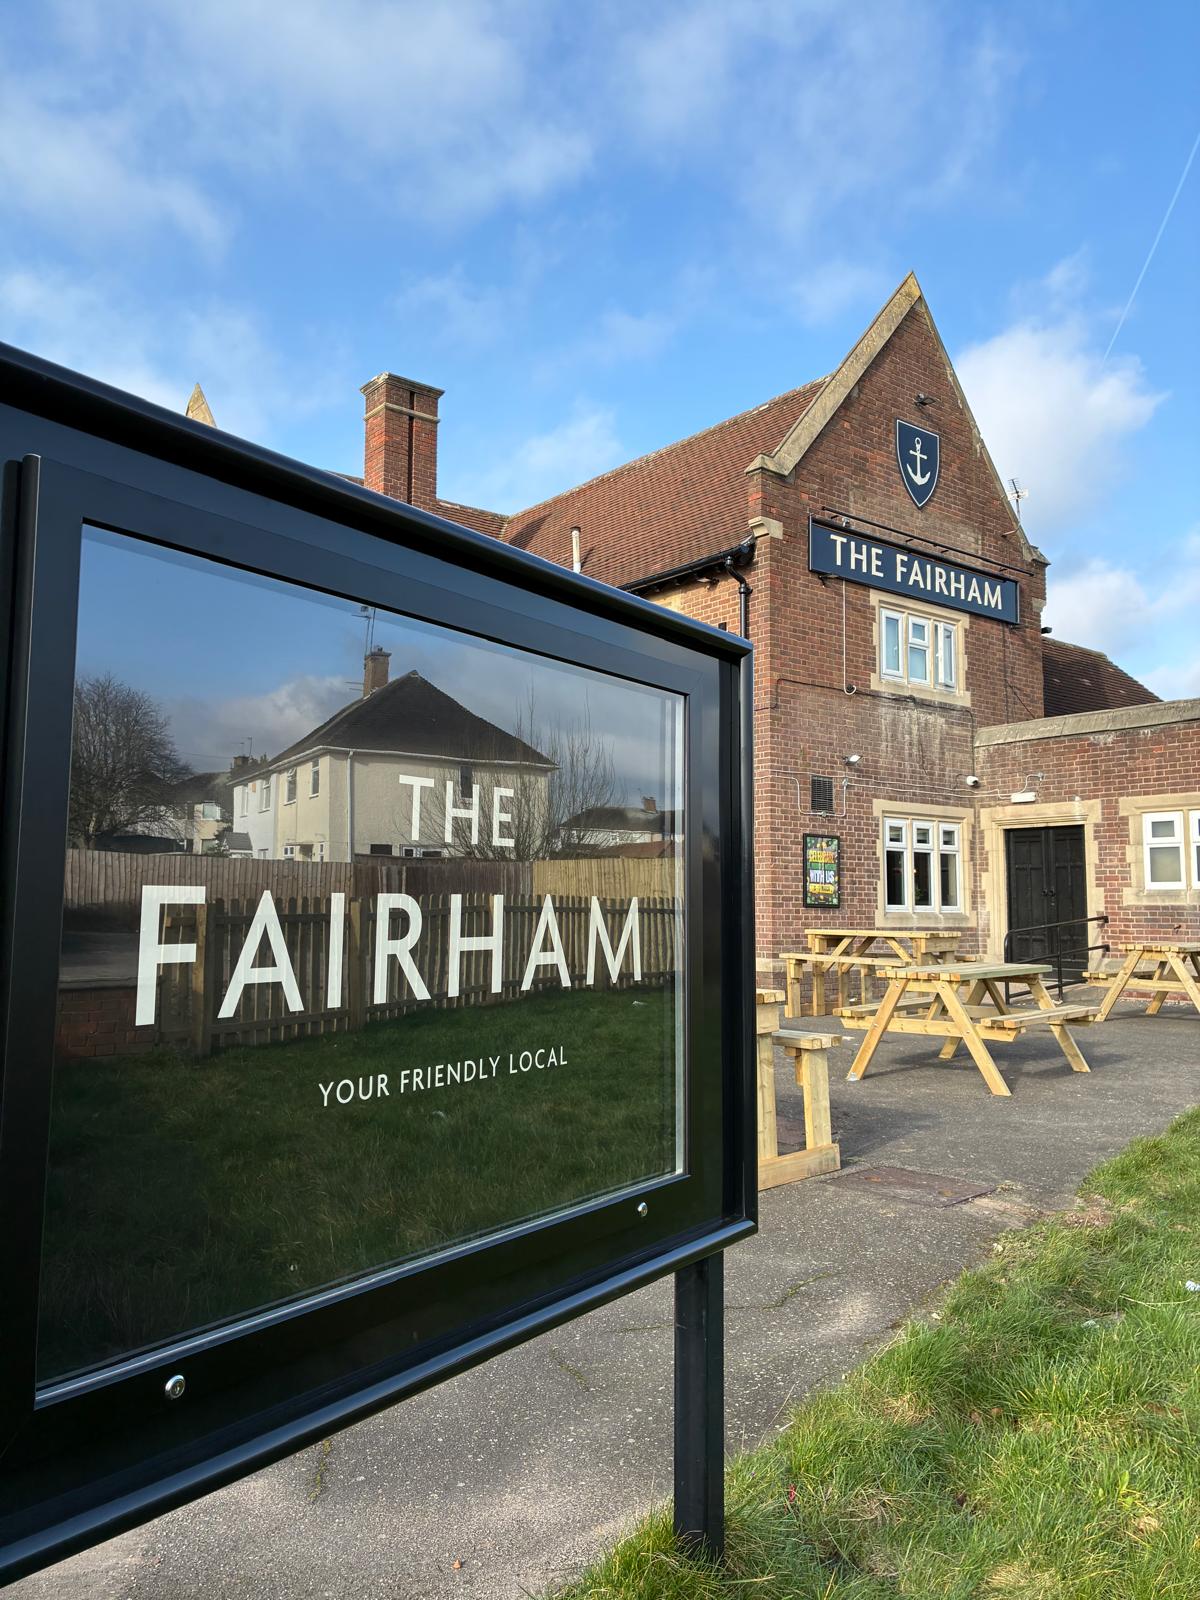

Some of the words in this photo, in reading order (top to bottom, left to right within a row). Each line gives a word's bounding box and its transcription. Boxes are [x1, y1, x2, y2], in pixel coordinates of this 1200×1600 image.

[830, 534, 884, 578] THE
[896, 553, 1003, 610] FAIRHAM
[399, 775, 515, 848] THE
[809, 870, 825, 883] WITH
[825, 870, 834, 883] US
[135, 884, 643, 1026] FAIRHAM
[318, 1073, 390, 1107] YOUR
[400, 1055, 501, 1094] FRIENDLY
[509, 1045, 568, 1075] LOCAL
